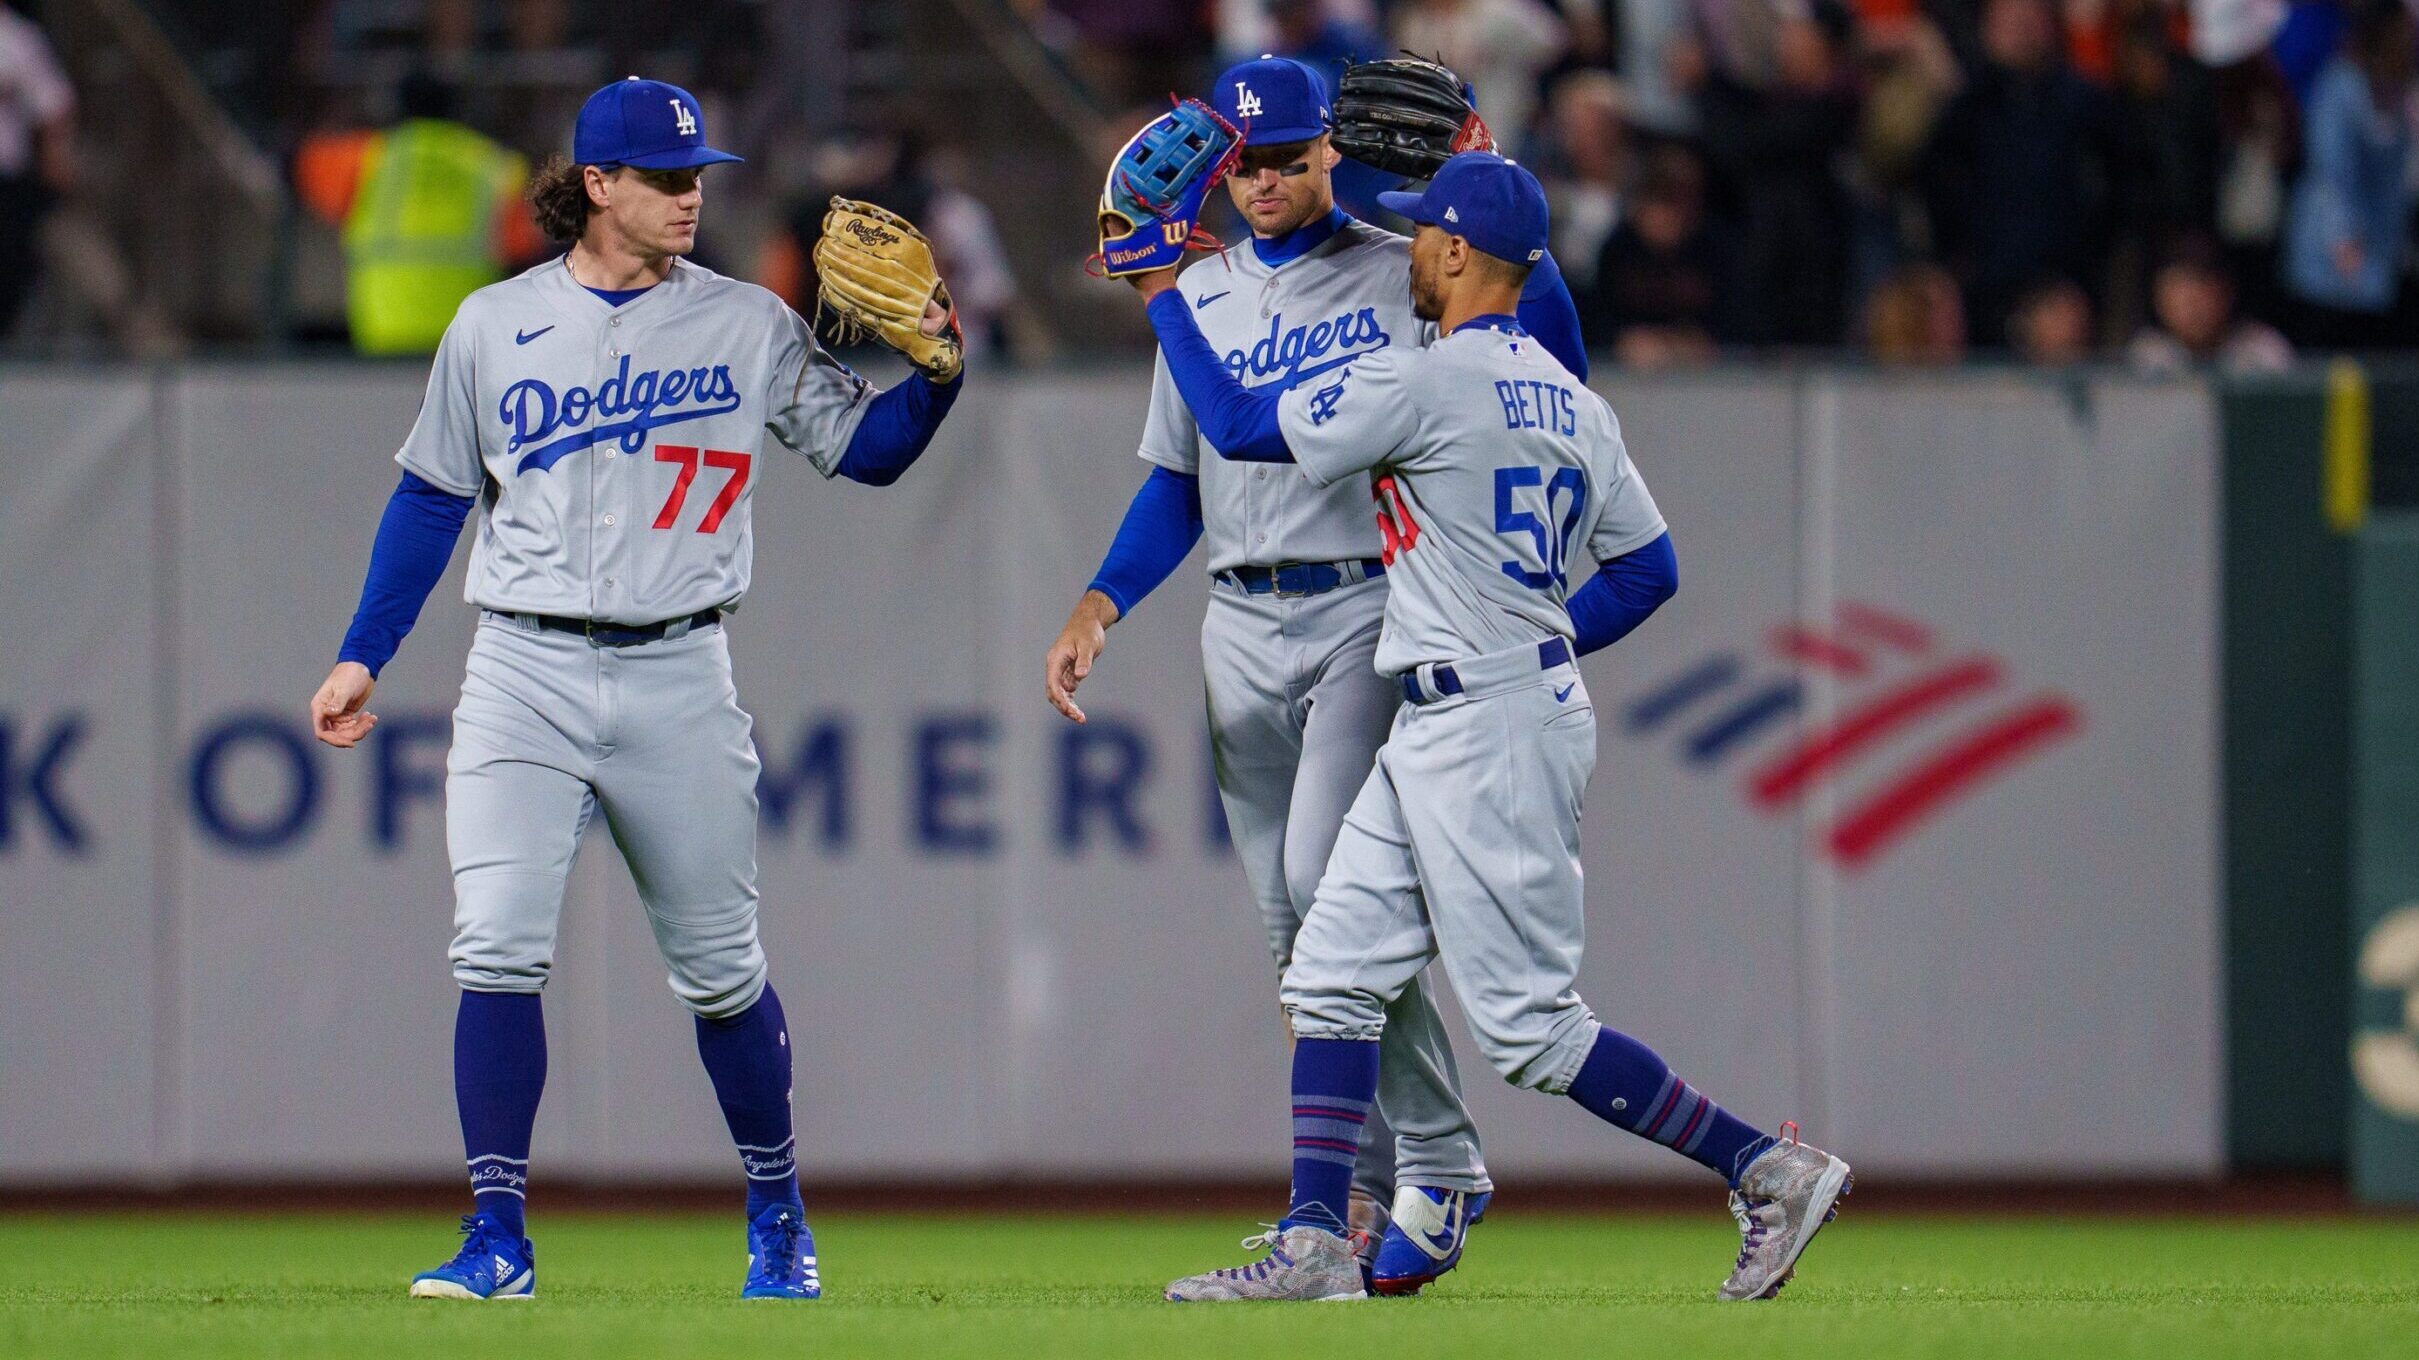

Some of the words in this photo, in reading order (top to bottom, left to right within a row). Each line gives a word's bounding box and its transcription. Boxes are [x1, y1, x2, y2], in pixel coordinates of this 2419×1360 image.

[669, 99, 697, 136] LA
[1235, 82, 1263, 117] LA
[846, 218, 900, 246] Rawlings
[1109, 245, 1157, 265] Wilson
[1224, 306, 1380, 388] odgers
[499, 354, 740, 458] Dodgers
[1495, 380, 1576, 437] BETTS
[652, 444, 752, 534] 77
[1494, 466, 1587, 598] 50
[189, 707, 453, 861] OF
